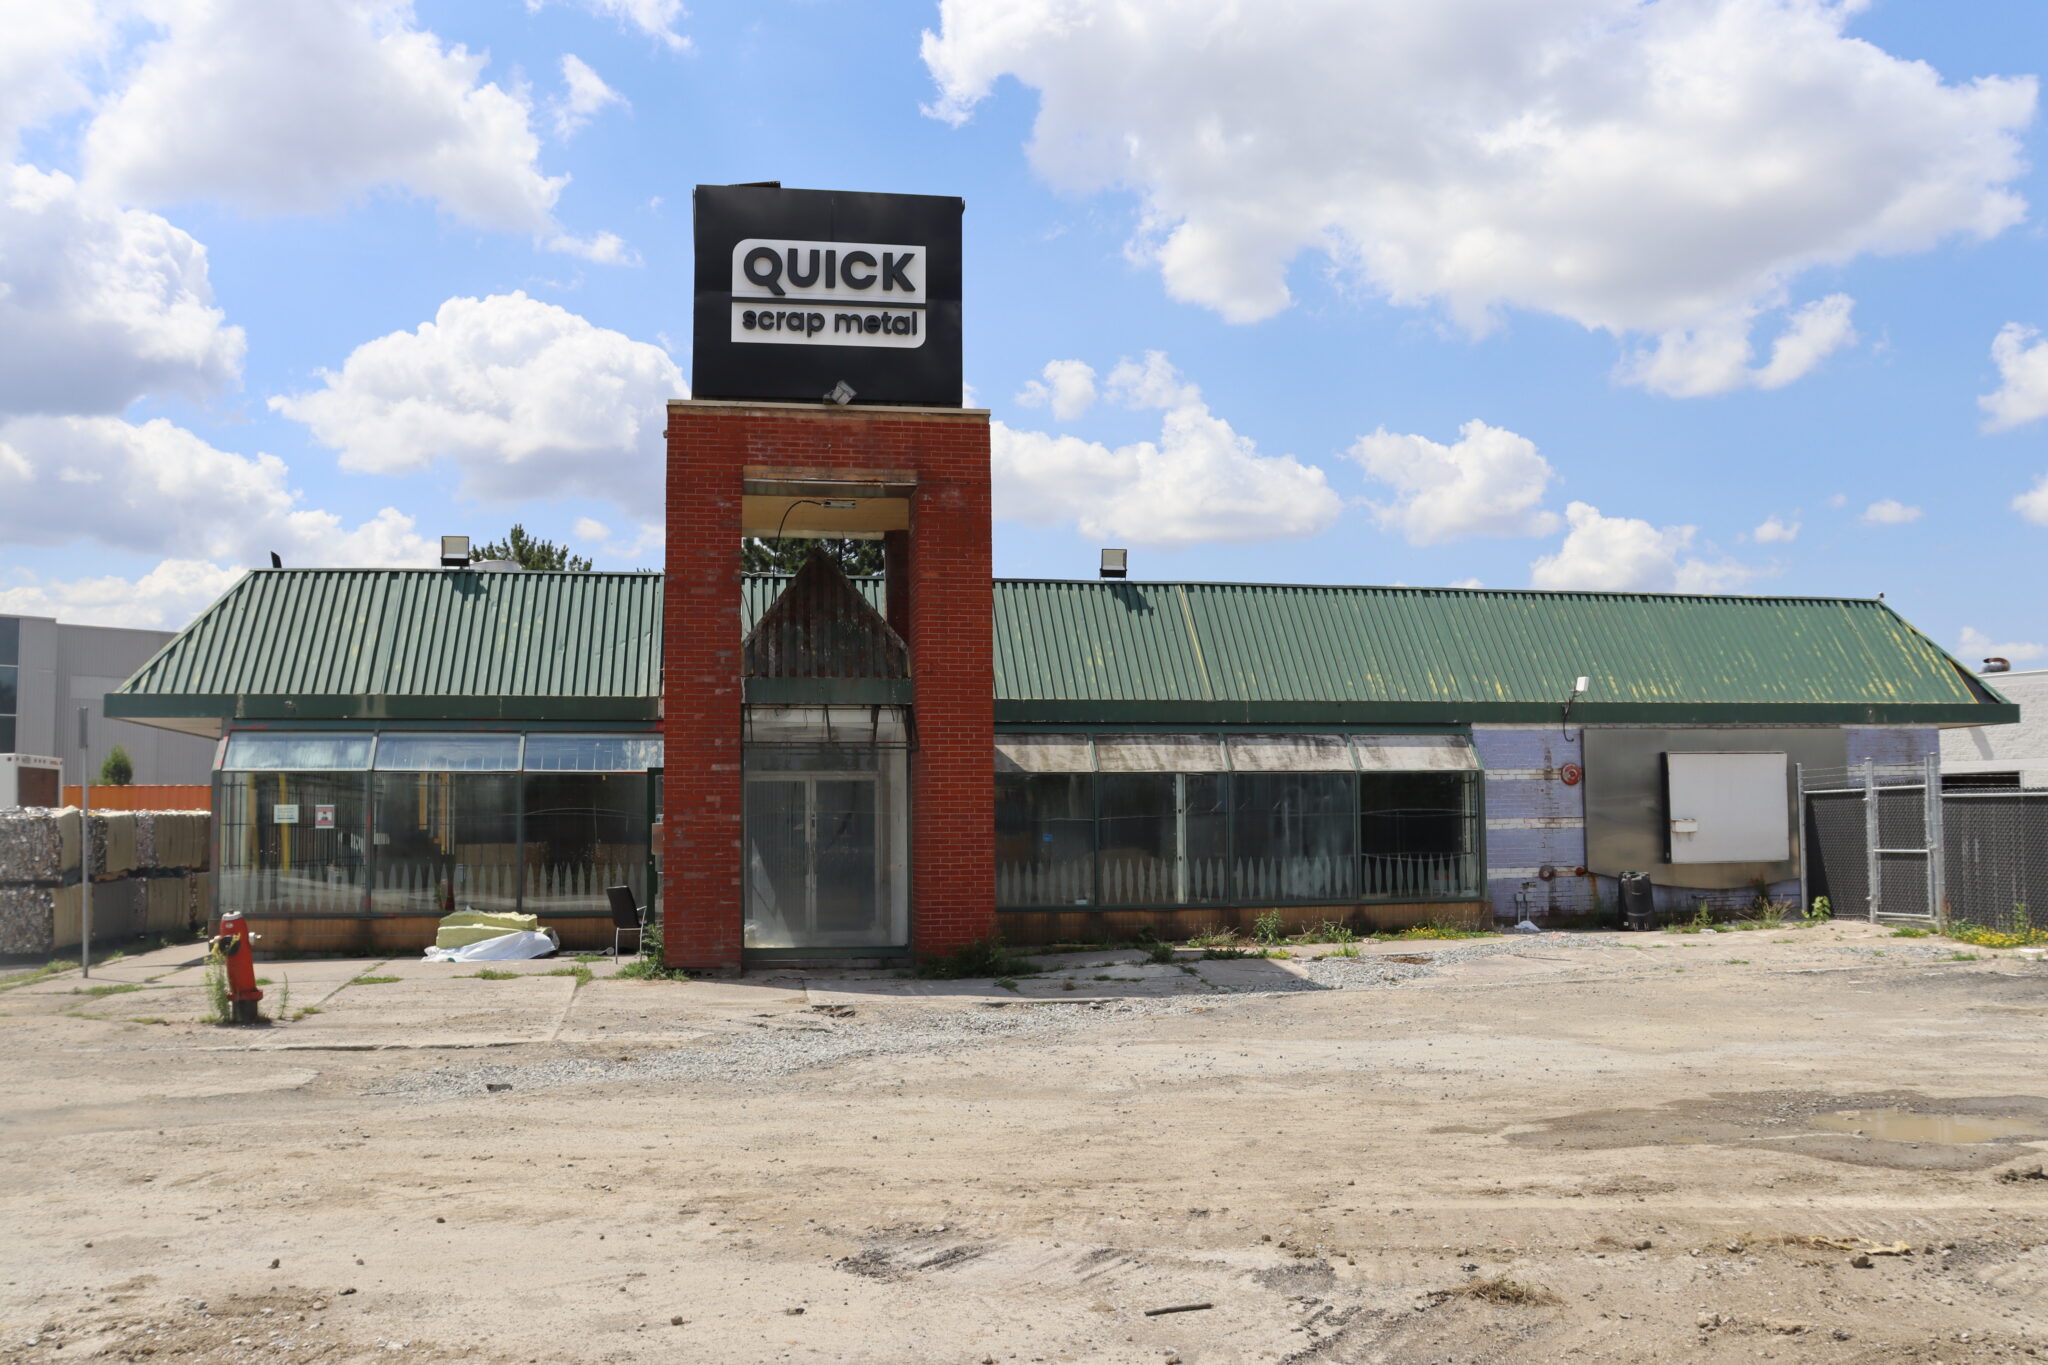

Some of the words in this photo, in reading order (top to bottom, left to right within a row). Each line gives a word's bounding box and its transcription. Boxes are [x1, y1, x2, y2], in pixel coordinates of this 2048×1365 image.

[743, 246, 916, 296] QUICK
[742, 309, 825, 338] scrap
[834, 311, 918, 336] metal
